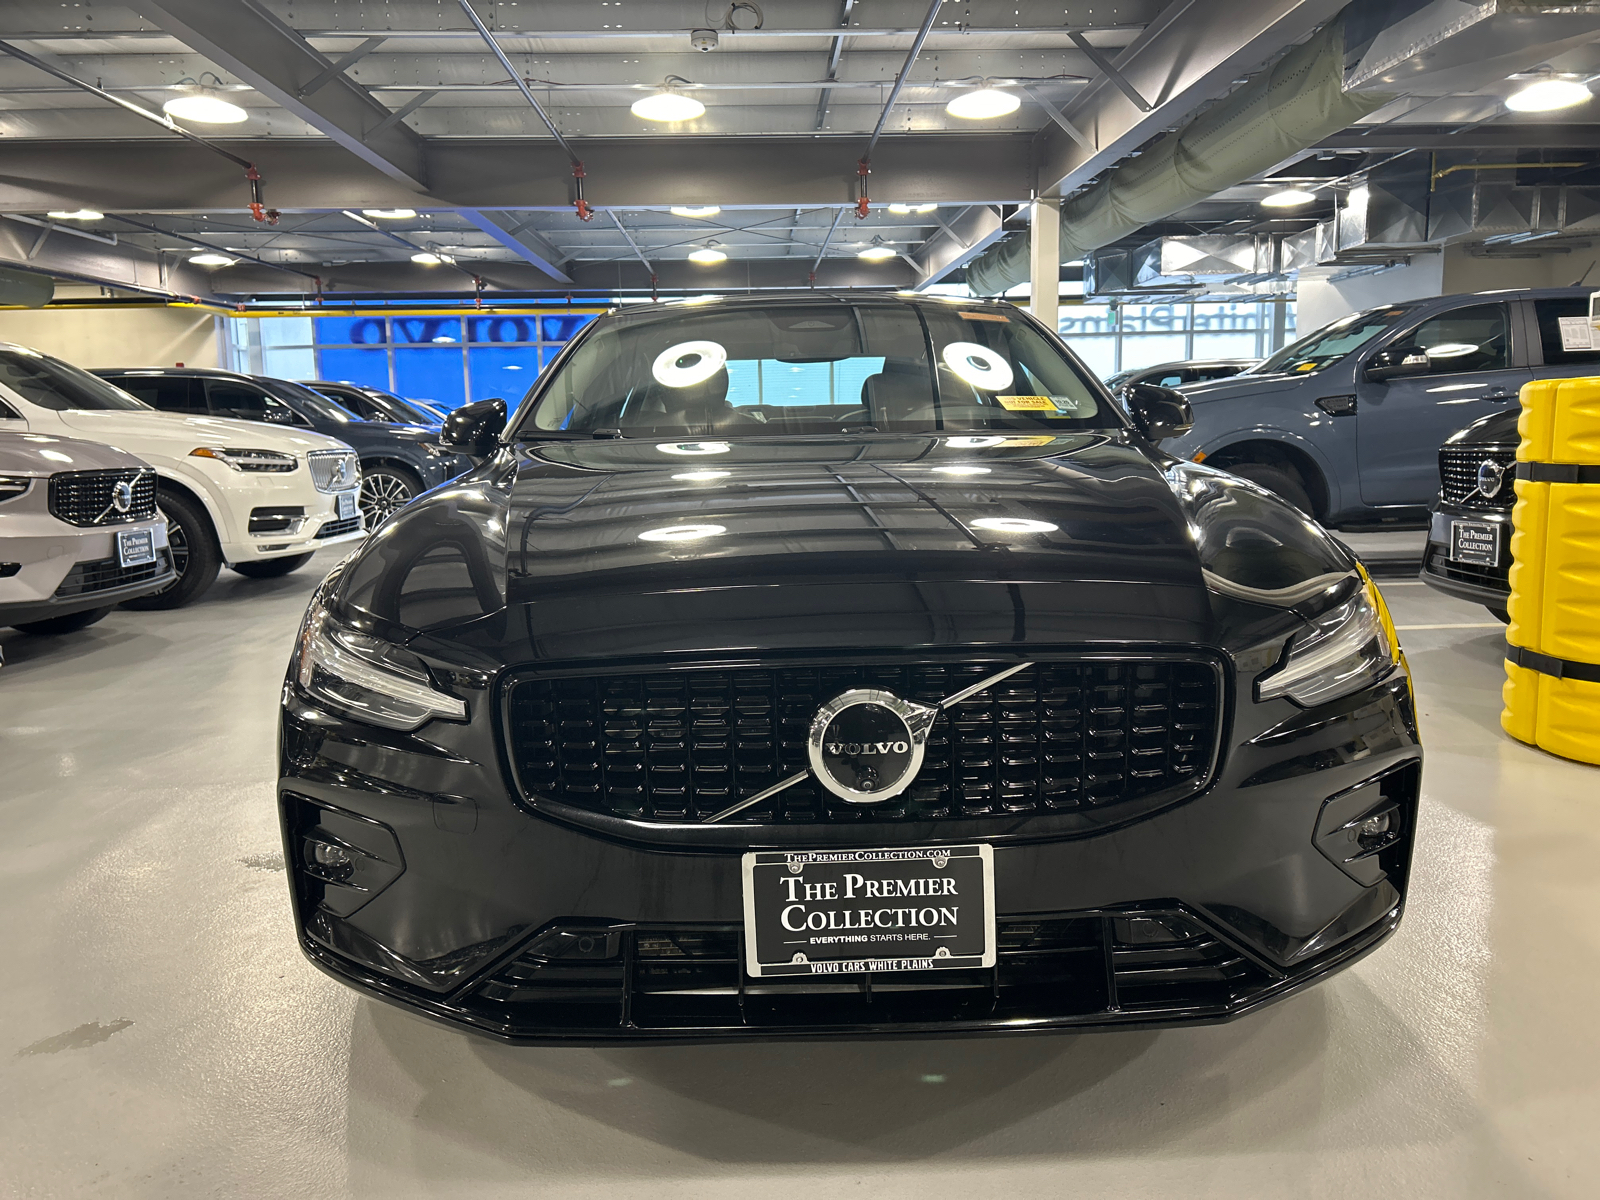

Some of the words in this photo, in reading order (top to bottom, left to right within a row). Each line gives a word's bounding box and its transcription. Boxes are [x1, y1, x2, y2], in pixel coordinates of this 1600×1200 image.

[825, 741, 909, 755] VOLVO
[780, 875, 838, 902] THE
[843, 873, 959, 899] PREMIER
[780, 904, 959, 932] COLLECTION
[810, 934, 868, 945] EVERYTHING
[870, 934, 903, 942] STARTS
[905, 933, 931, 942] HERE.
[810, 963, 839, 973] VOLVO
[842, 961, 865, 972] CARS
[869, 960, 898, 971] WHITE
[901, 959, 934, 970] PLAINS
